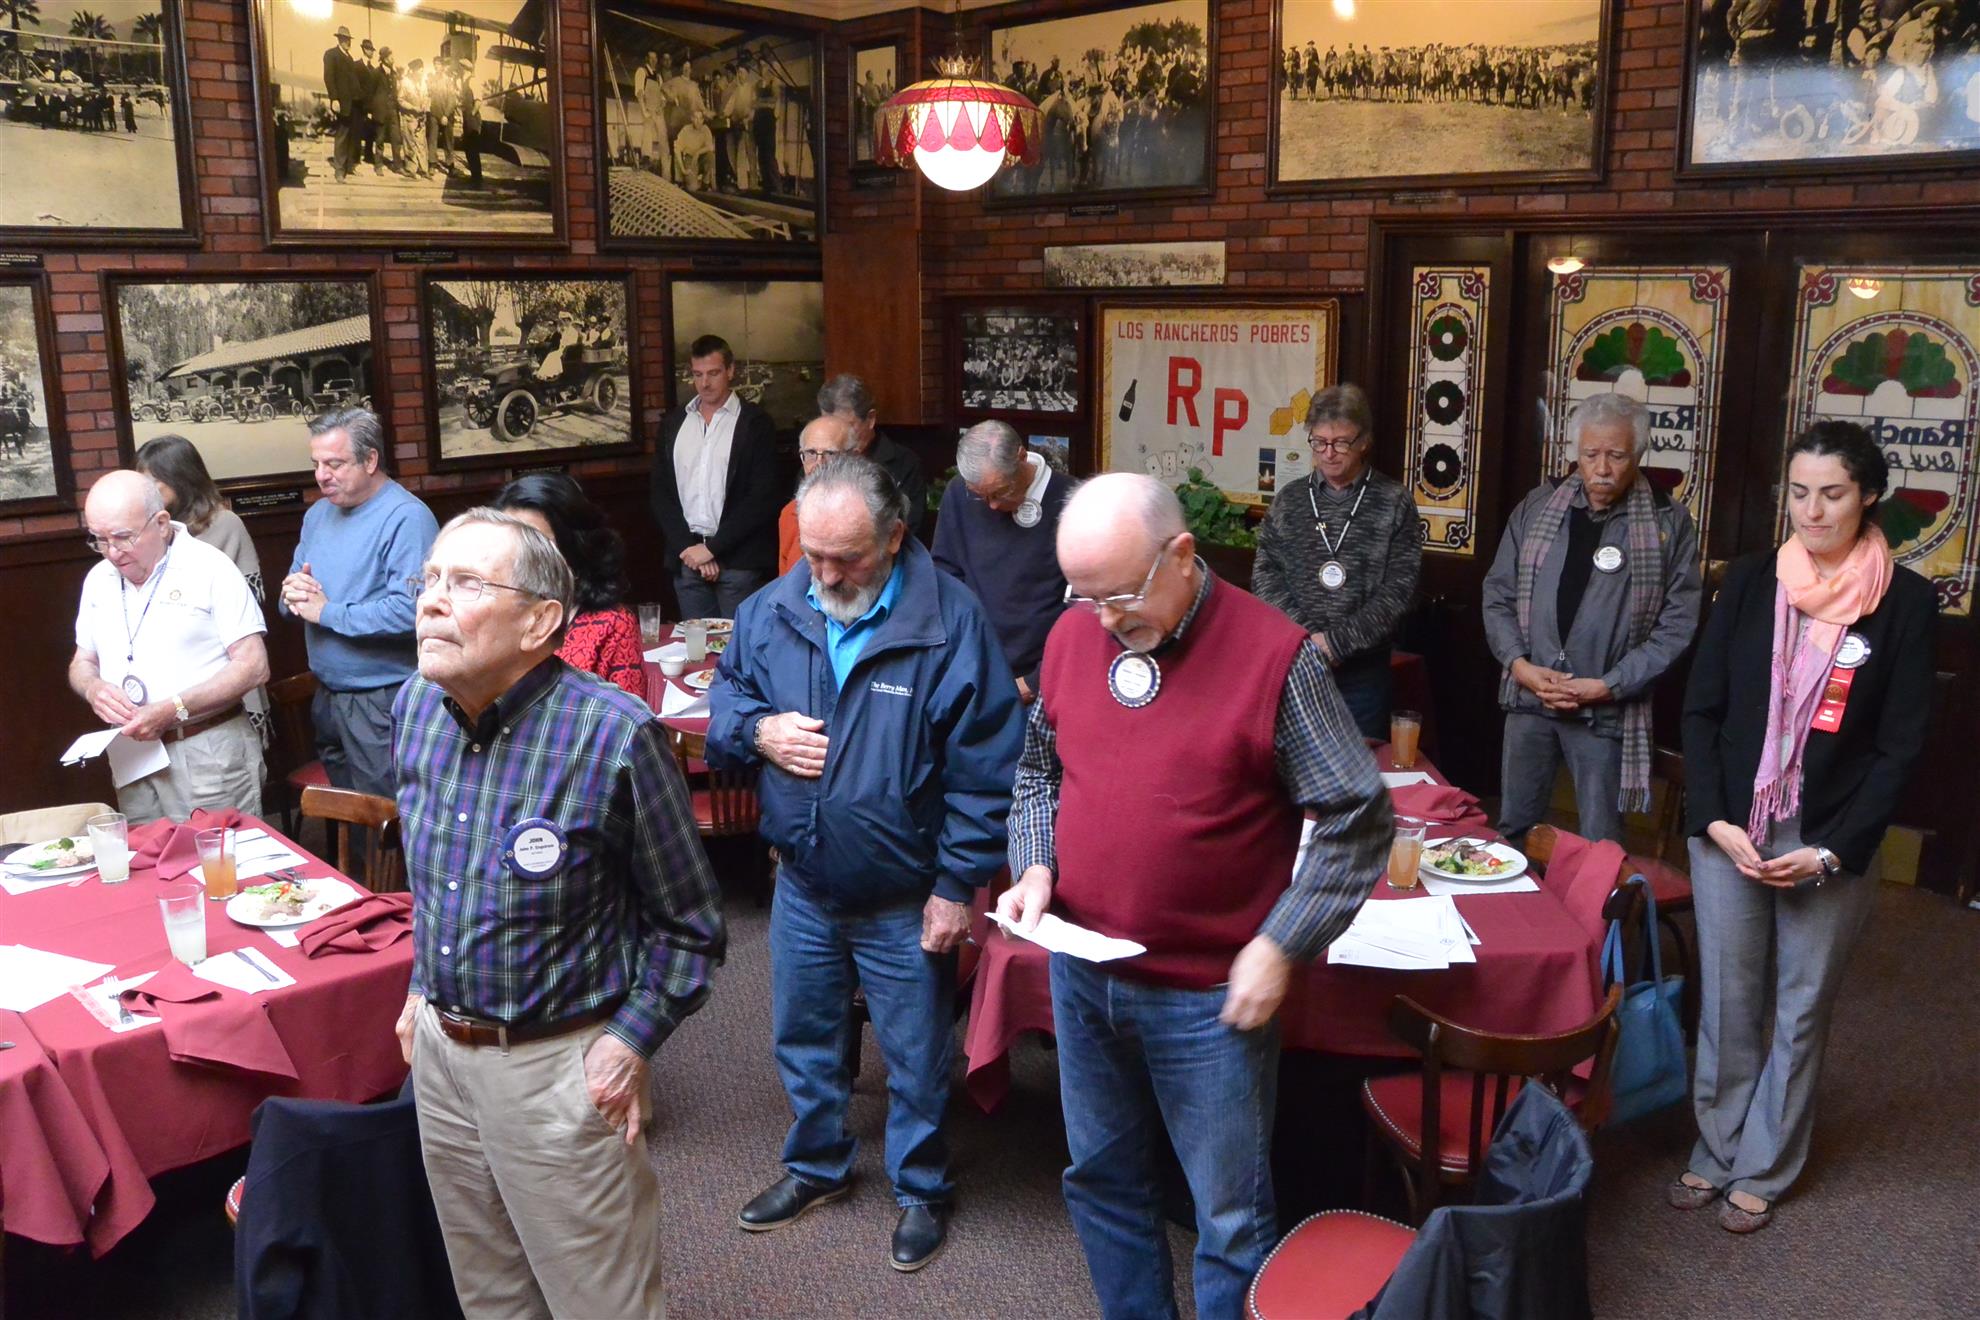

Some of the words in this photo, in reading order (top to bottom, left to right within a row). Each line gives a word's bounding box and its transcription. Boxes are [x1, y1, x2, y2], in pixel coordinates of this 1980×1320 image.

[1118, 321, 1144, 340] LOS
[1154, 322, 1239, 343] RANCHEROS
[1250, 324, 1311, 343] POBRES
